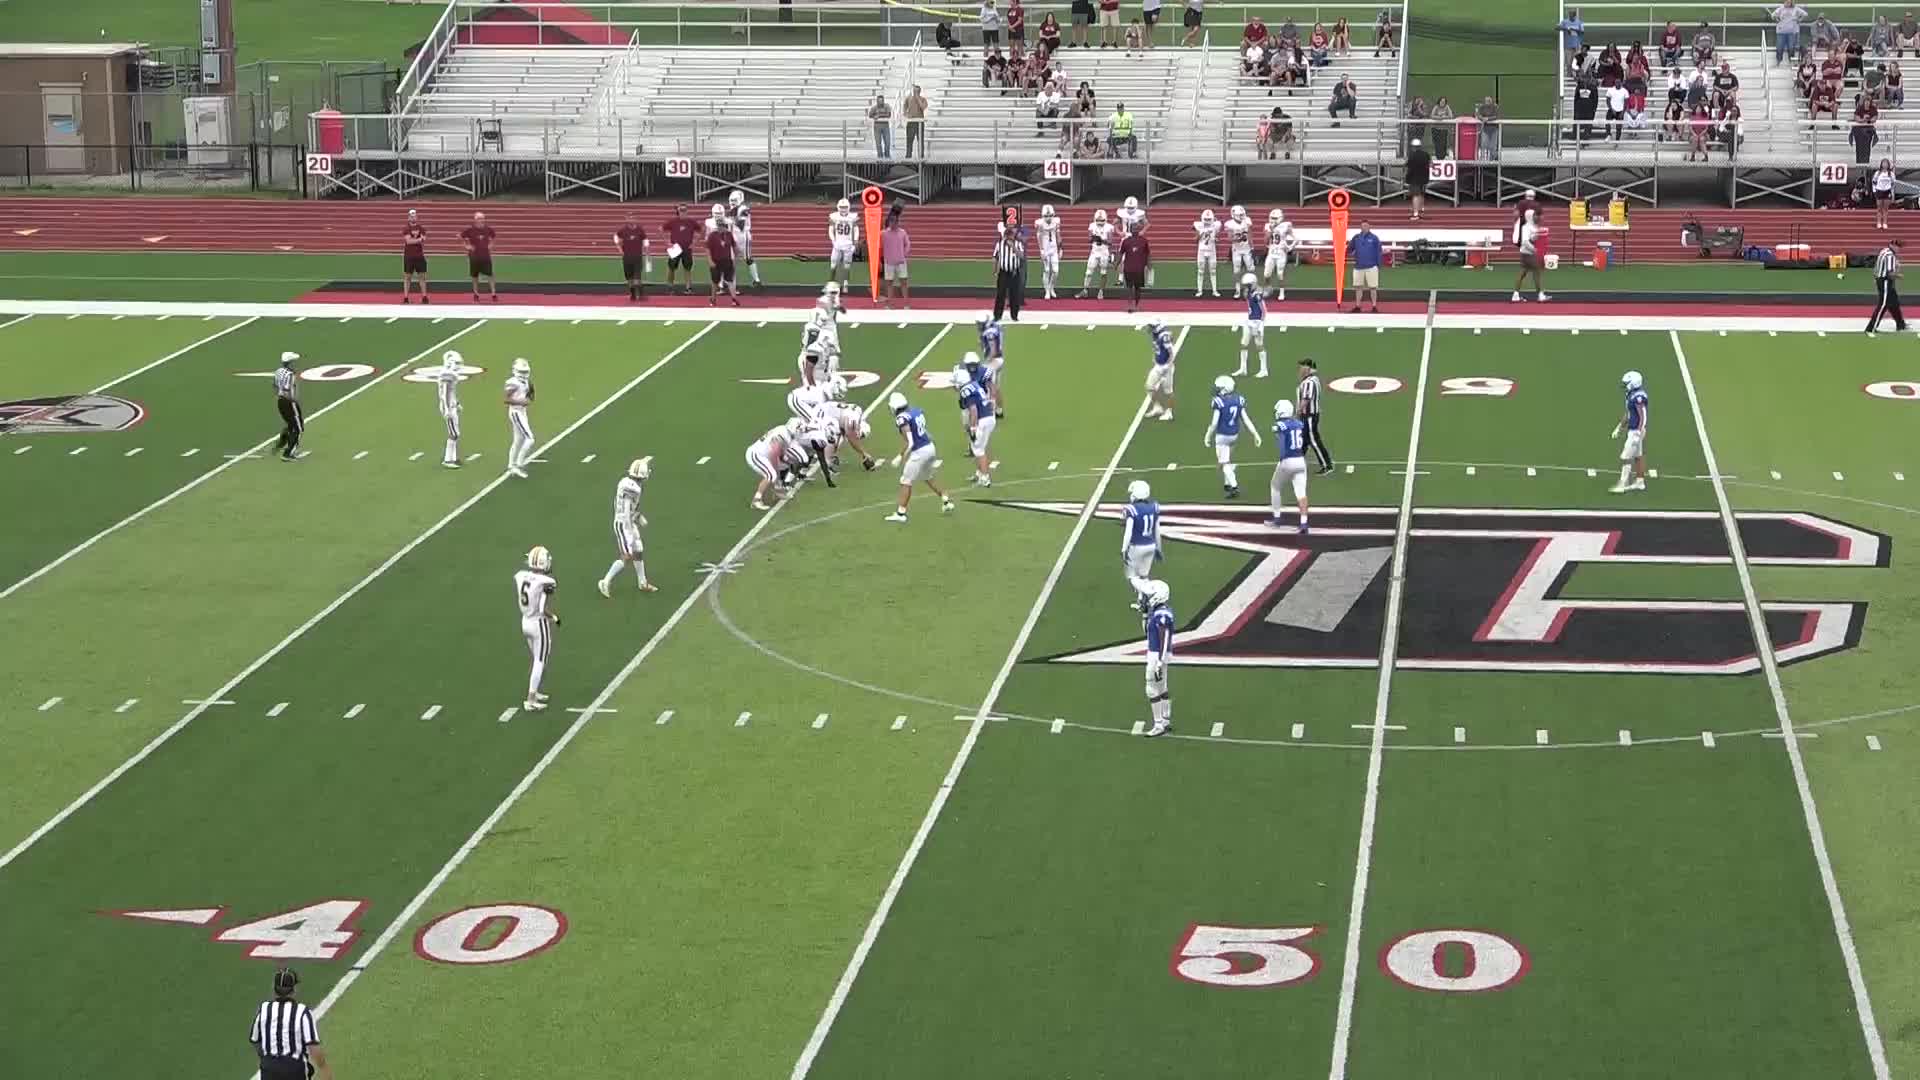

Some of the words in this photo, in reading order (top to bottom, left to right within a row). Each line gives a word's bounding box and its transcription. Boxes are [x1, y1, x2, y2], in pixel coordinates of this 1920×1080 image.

[308, 157, 329, 171] 20
[668, 160, 689, 174] 30
[1047, 162, 1069, 176] 40
[1431, 163, 1454, 177] 50
[1823, 166, 1845, 180] 40
[1006, 207, 1017, 225] 2
[1229, 406, 1238, 426] 7
[1290, 429, 1304, 450] 16
[1142, 514, 1154, 537] 11
[520, 581, 531, 606] 5
